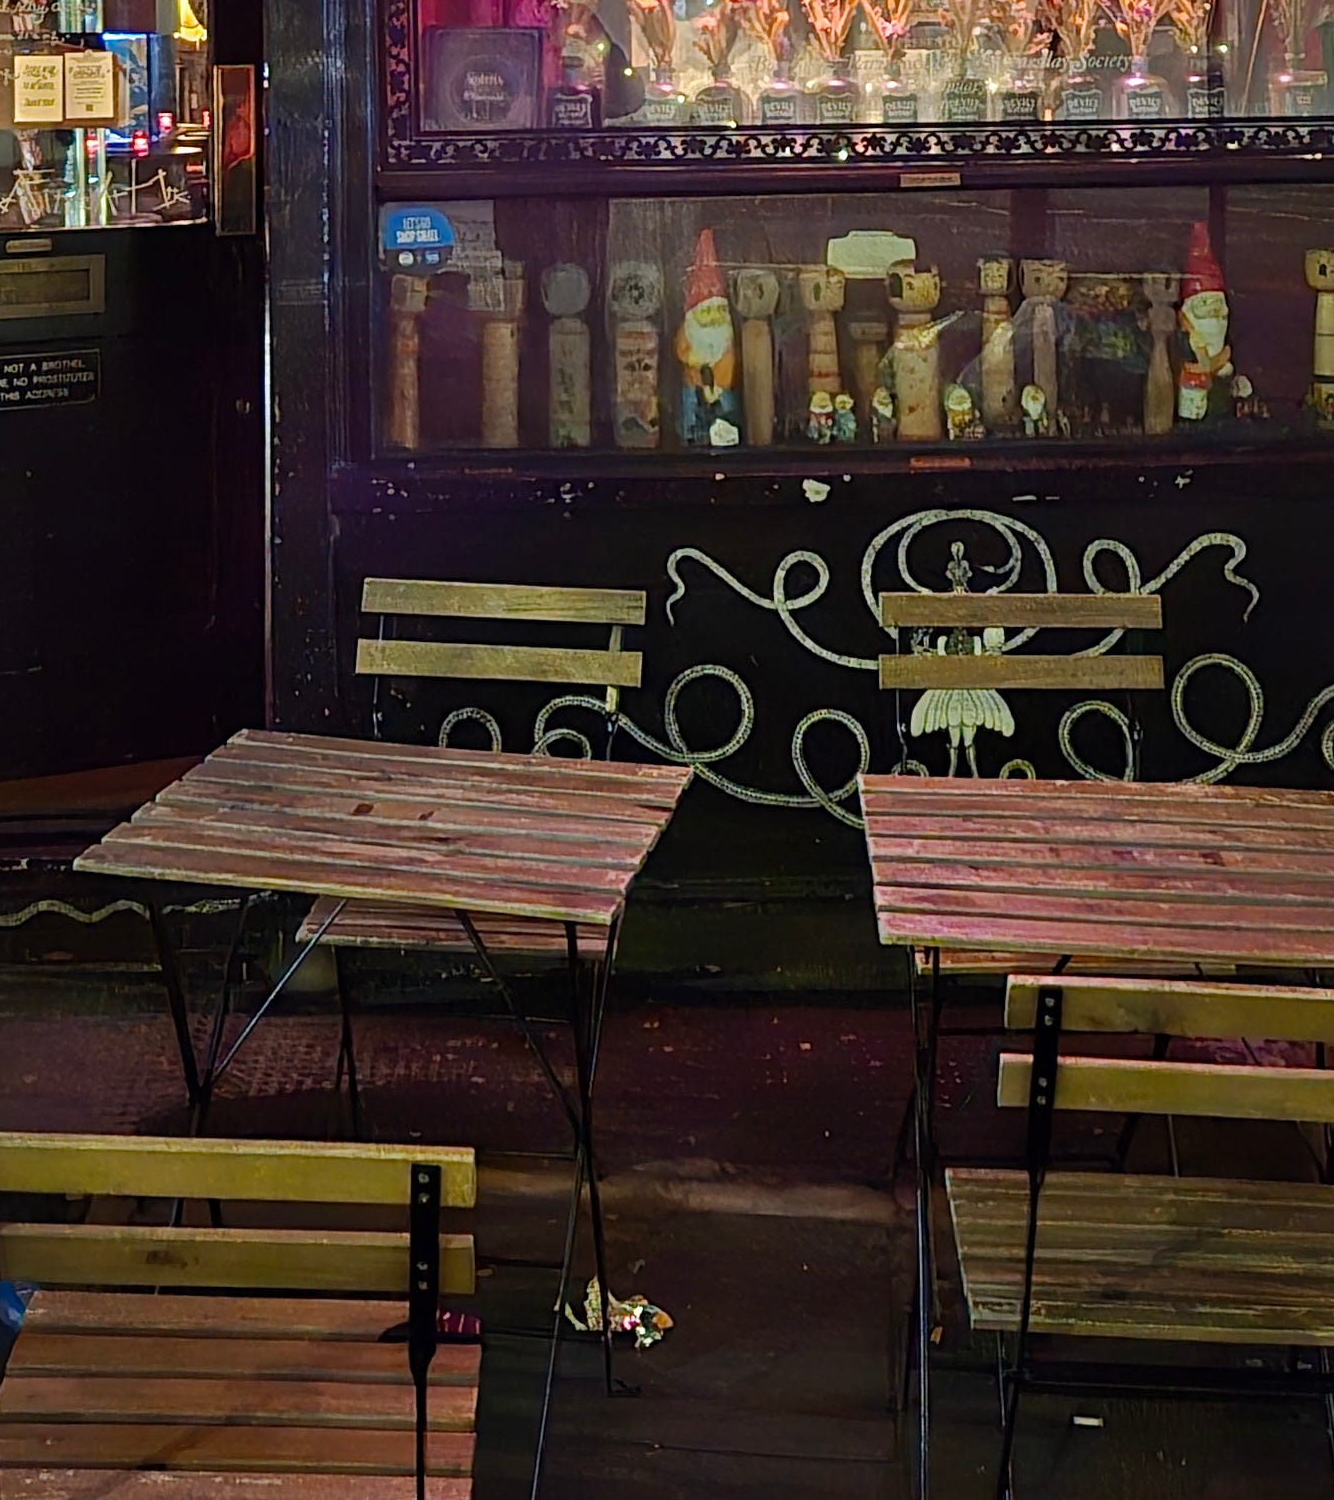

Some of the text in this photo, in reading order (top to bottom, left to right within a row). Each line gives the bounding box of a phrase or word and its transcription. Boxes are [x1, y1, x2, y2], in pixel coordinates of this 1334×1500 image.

[4, 363, 24, 373] NOT
[29, 362, 37, 371] A
[13, 376, 28, 387] NO
[0, 391, 20, 401] THIS
